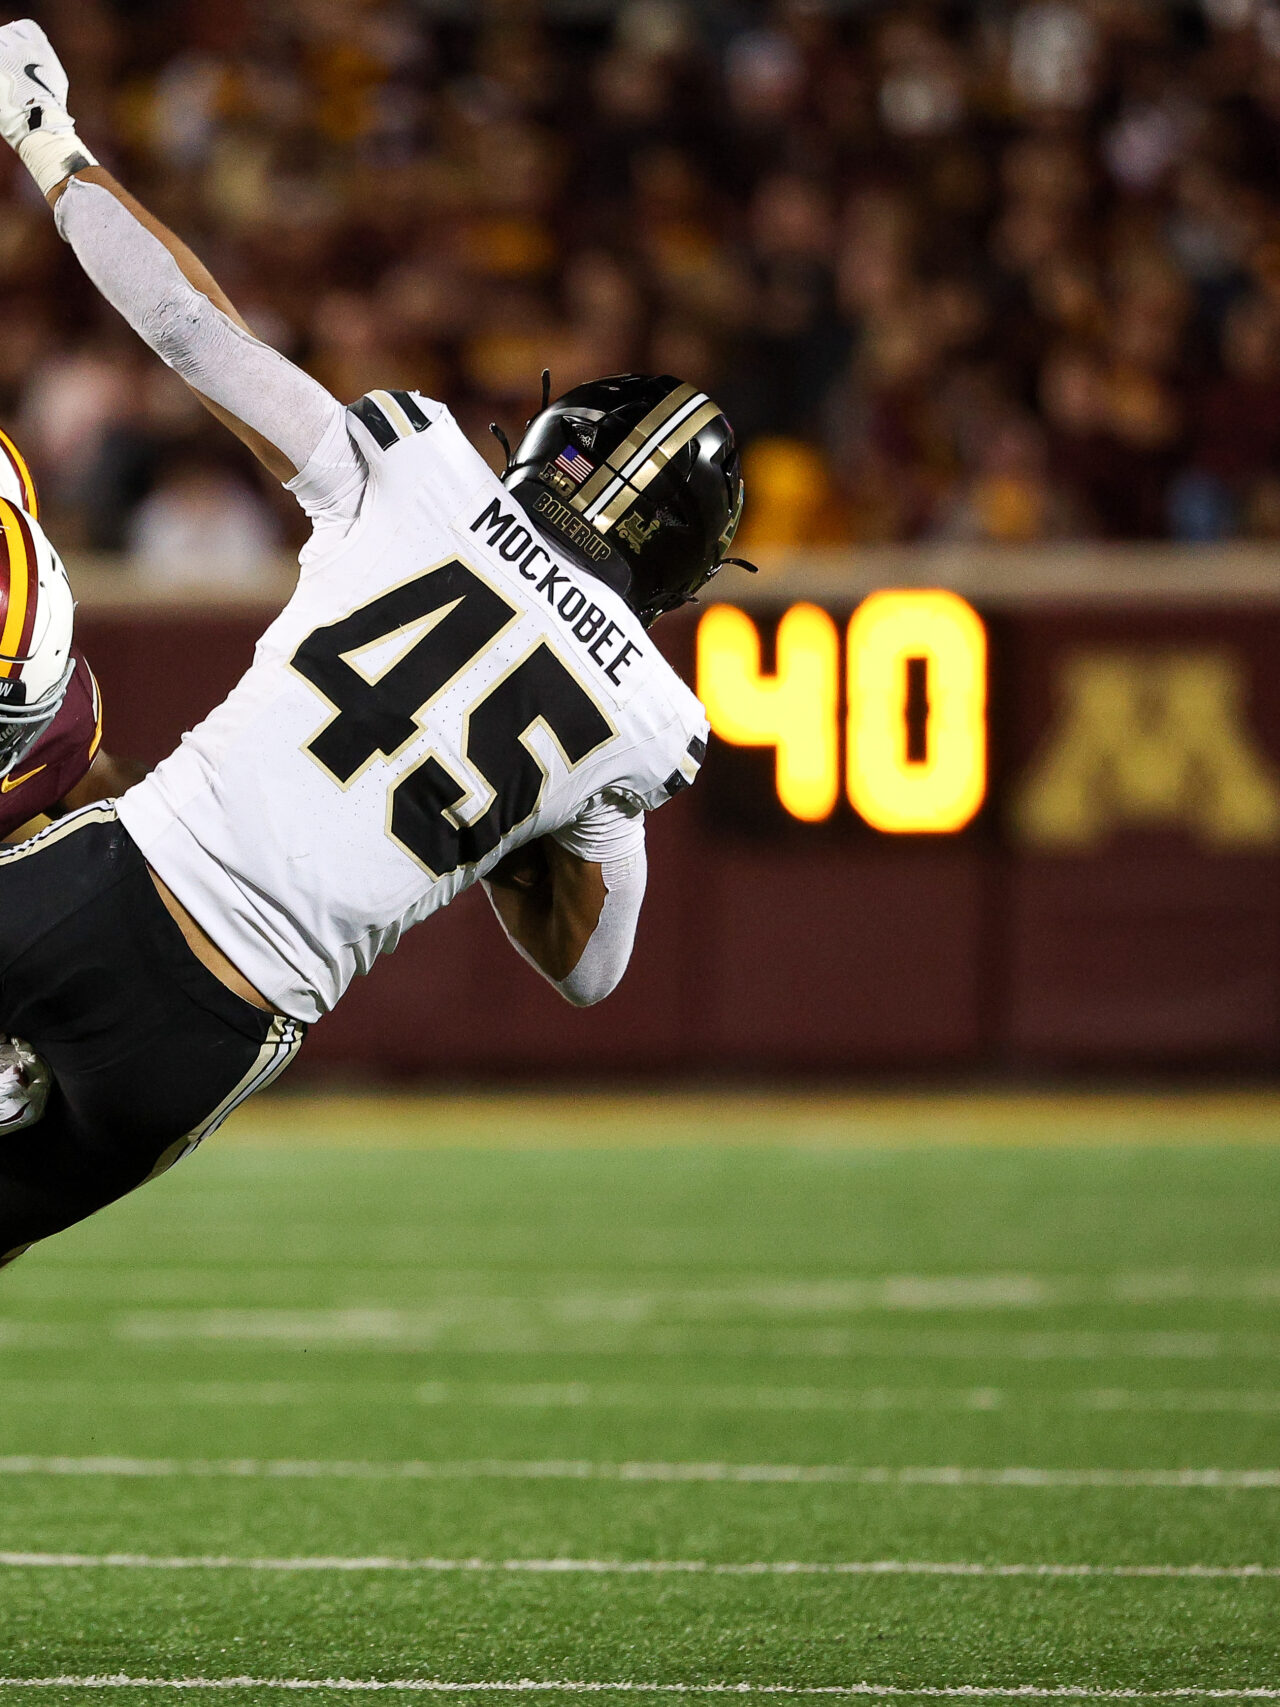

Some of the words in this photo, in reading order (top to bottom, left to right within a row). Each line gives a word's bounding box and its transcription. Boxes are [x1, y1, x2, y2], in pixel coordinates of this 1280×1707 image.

[470, 497, 643, 687] MOCKOBEE
[533, 492, 591, 547] BOILER
[584, 534, 611, 561] UP
[284, 552, 620, 882] 45
[697, 588, 988, 835] 40
